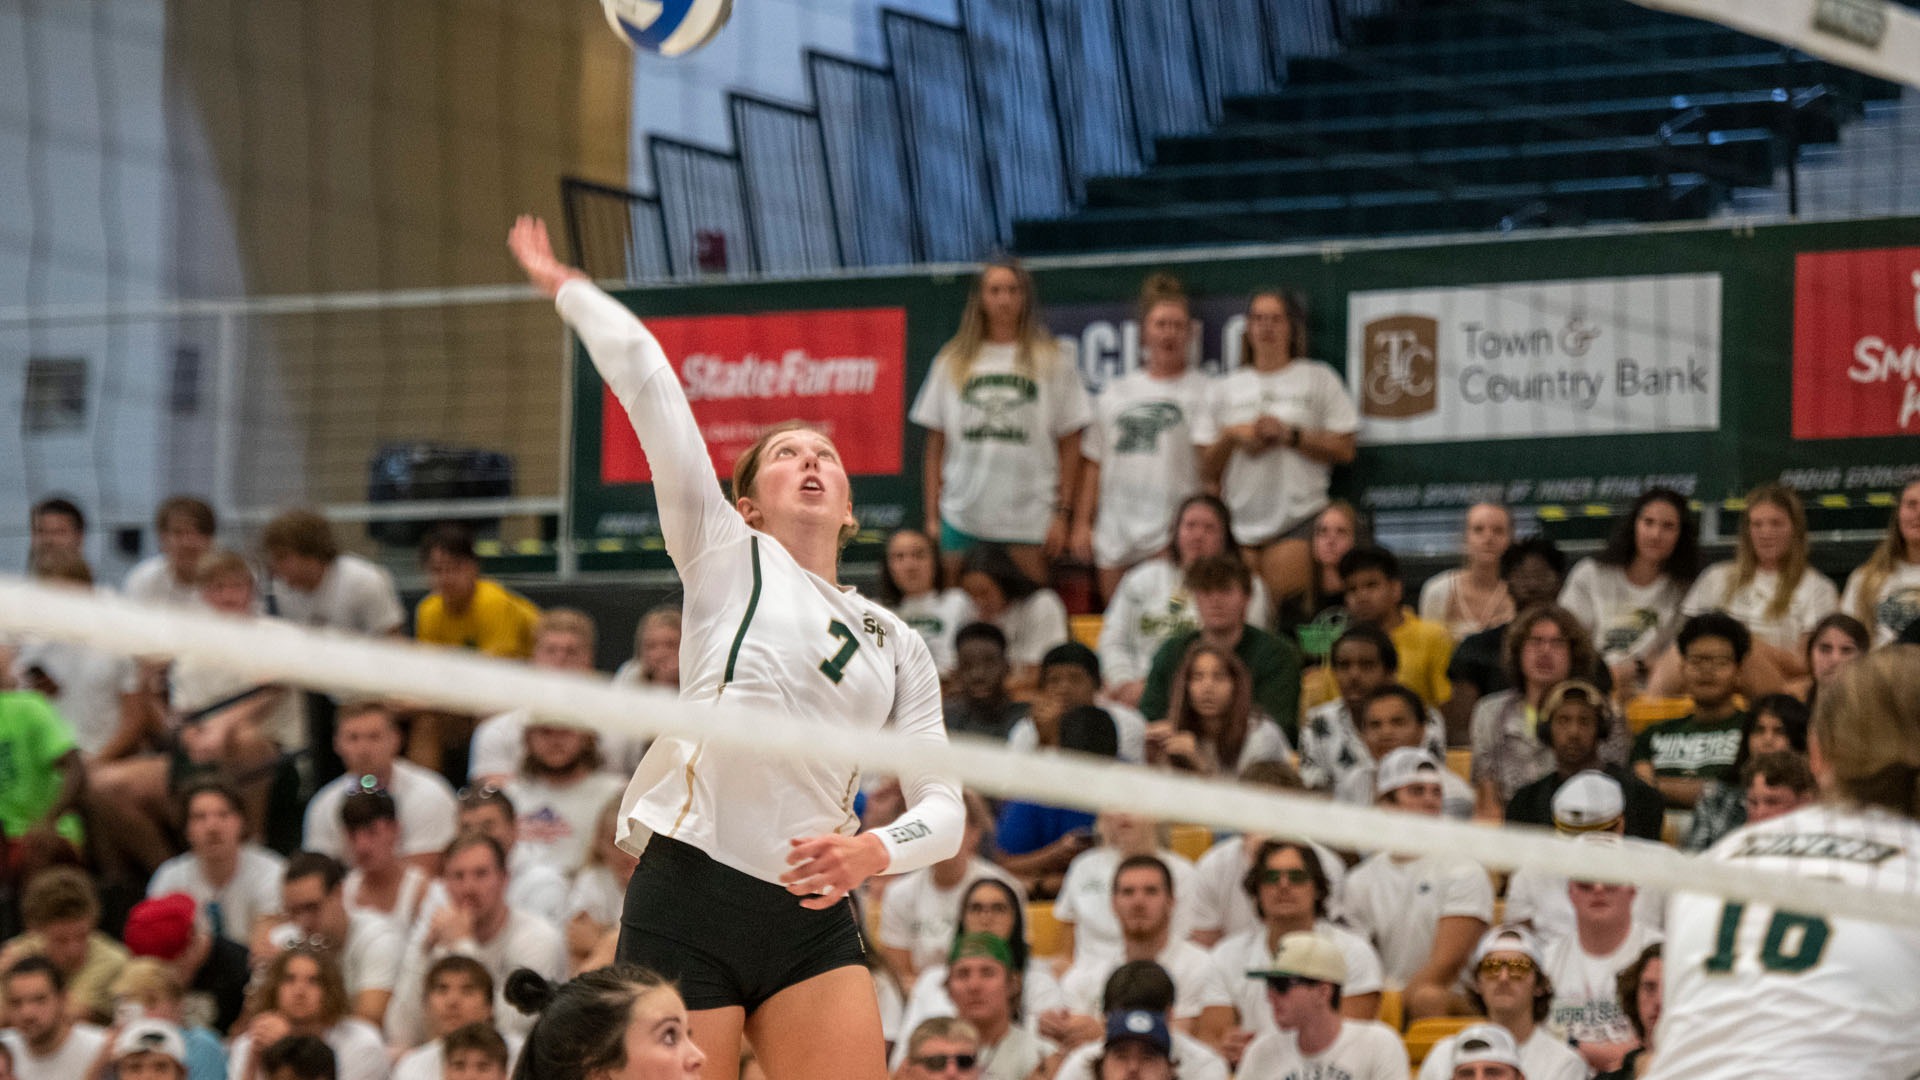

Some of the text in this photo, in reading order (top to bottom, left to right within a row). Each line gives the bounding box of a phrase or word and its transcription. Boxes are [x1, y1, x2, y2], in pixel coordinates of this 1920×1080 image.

[1460, 311, 1602, 360] Town &
[1459, 355, 1708, 410] Country Bank
[819, 617, 860, 685] 7
